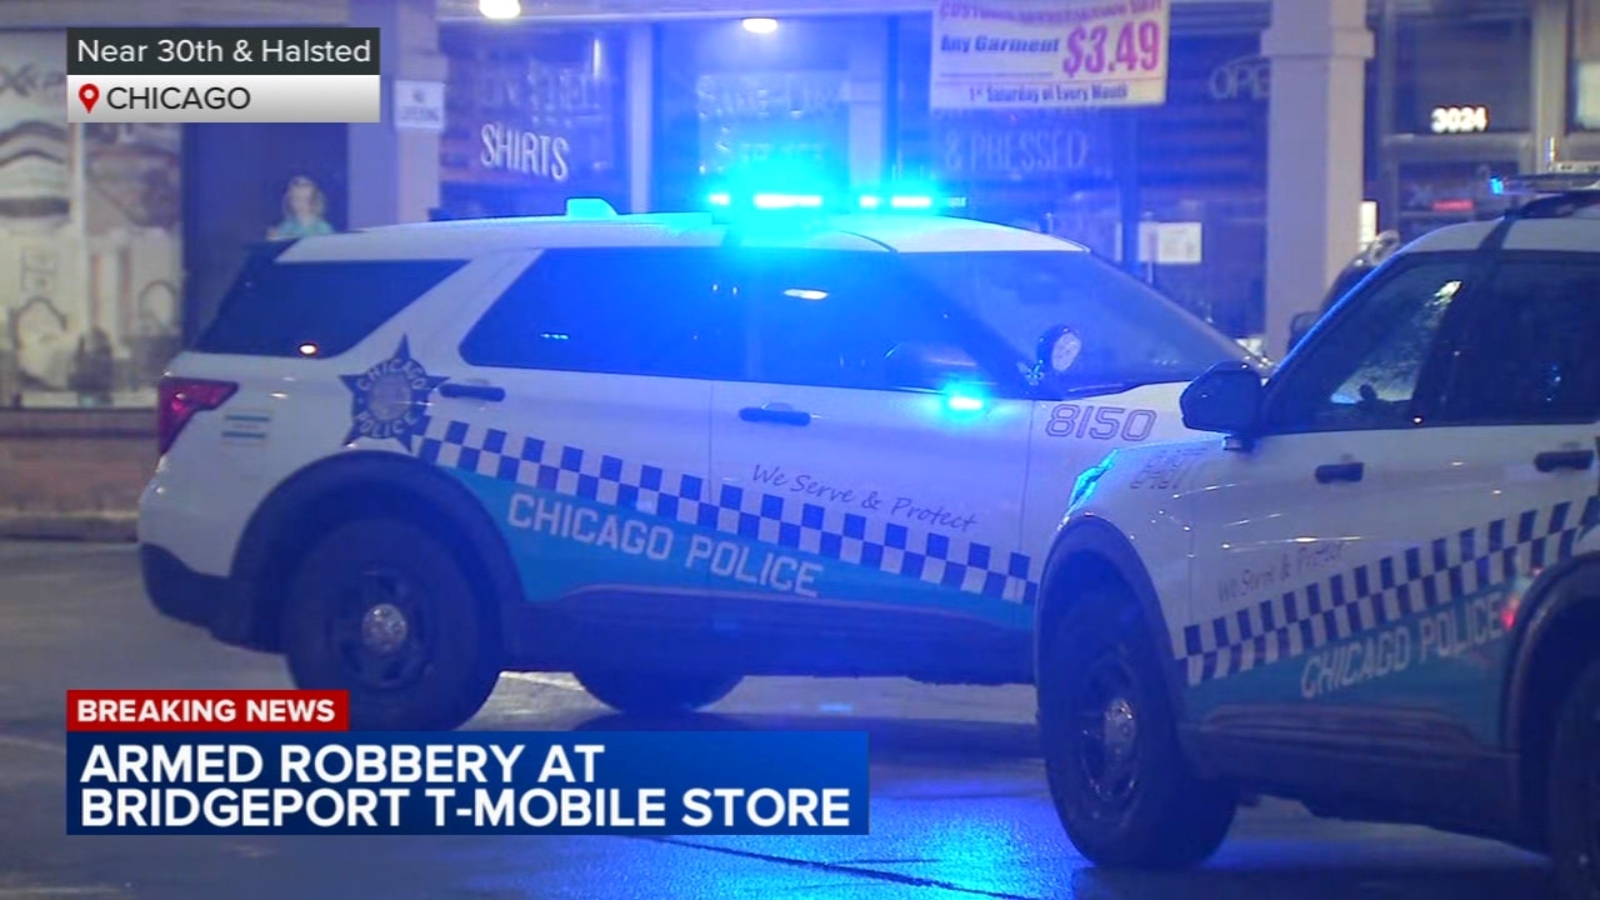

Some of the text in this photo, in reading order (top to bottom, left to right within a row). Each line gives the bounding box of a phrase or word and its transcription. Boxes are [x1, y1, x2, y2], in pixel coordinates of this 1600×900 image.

[941, 34, 1060, 53] Any Garment
[1063, 20, 1160, 77] $3.49
[987, 86, 1039, 102] Saturday
[1056, 85, 1088, 101] Every
[1208, 64, 1270, 101] OPE
[1431, 106, 1488, 133] 3024
[480, 123, 570, 181] SHIRTS
[970, 129, 1088, 172] PRESSED
[356, 358, 426, 392] CHICAGO
[355, 409, 417, 438] POLICE
[1045, 403, 1157, 442] 8150
[752, 463, 977, 533] We Serve & Protect
[507, 493, 824, 598] CHICAGO POLICE
[1301, 592, 1502, 699] CHICAGO POLICE
